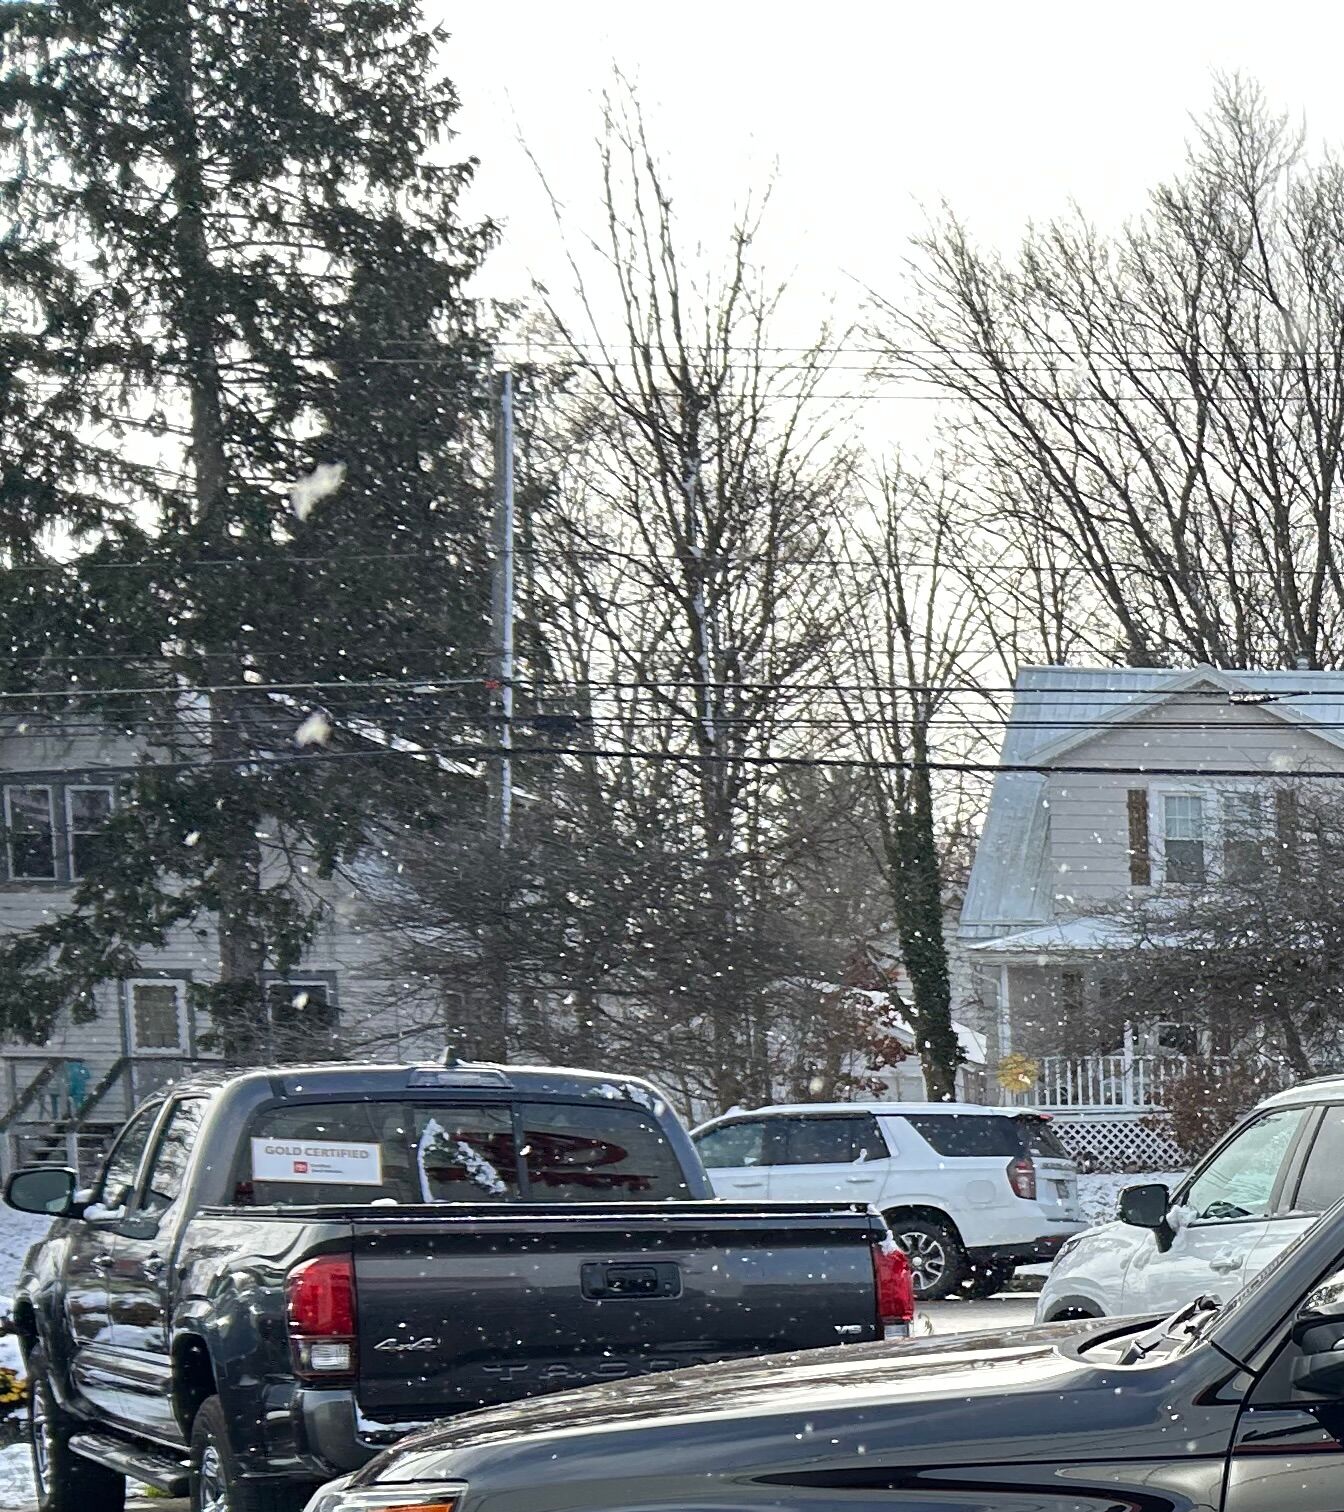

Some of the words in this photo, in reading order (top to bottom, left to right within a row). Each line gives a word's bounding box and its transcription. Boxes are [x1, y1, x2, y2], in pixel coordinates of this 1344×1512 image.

[265, 1145, 302, 1156] GOLD
[304, 1147, 369, 1159] CERTIFIED
[834, 1324, 862, 1335] V6
[480, 1358, 706, 1382] TACO
